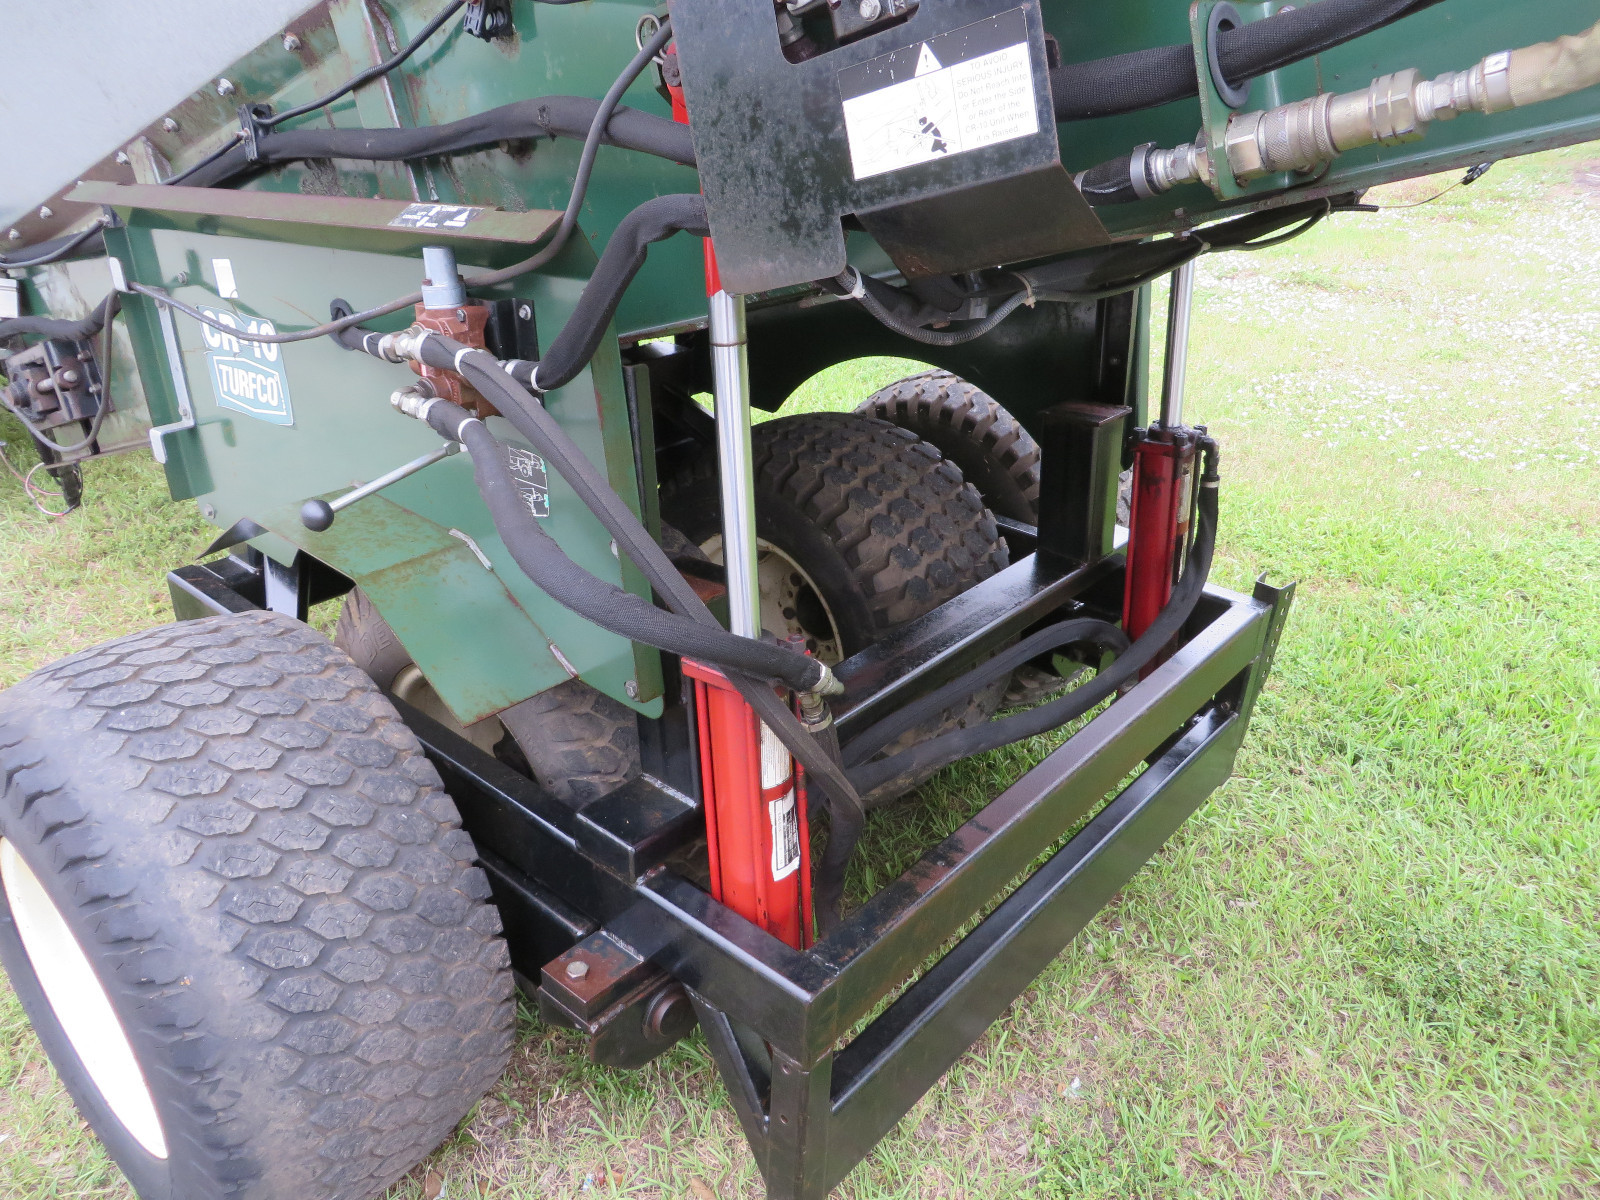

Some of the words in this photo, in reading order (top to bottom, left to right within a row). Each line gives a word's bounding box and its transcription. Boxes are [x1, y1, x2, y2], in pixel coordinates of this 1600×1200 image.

[971, 62, 980, 70] TO
[983, 53, 1008, 66] AVOID
[957, 71, 992, 87] SERIOUS
[994, 60, 1023, 75] INJURY
[958, 91, 968, 99] Do
[1007, 111, 1029, 121] When
[202, 310, 278, 362] CR-10
[218, 363, 279, 407] TURFCO
